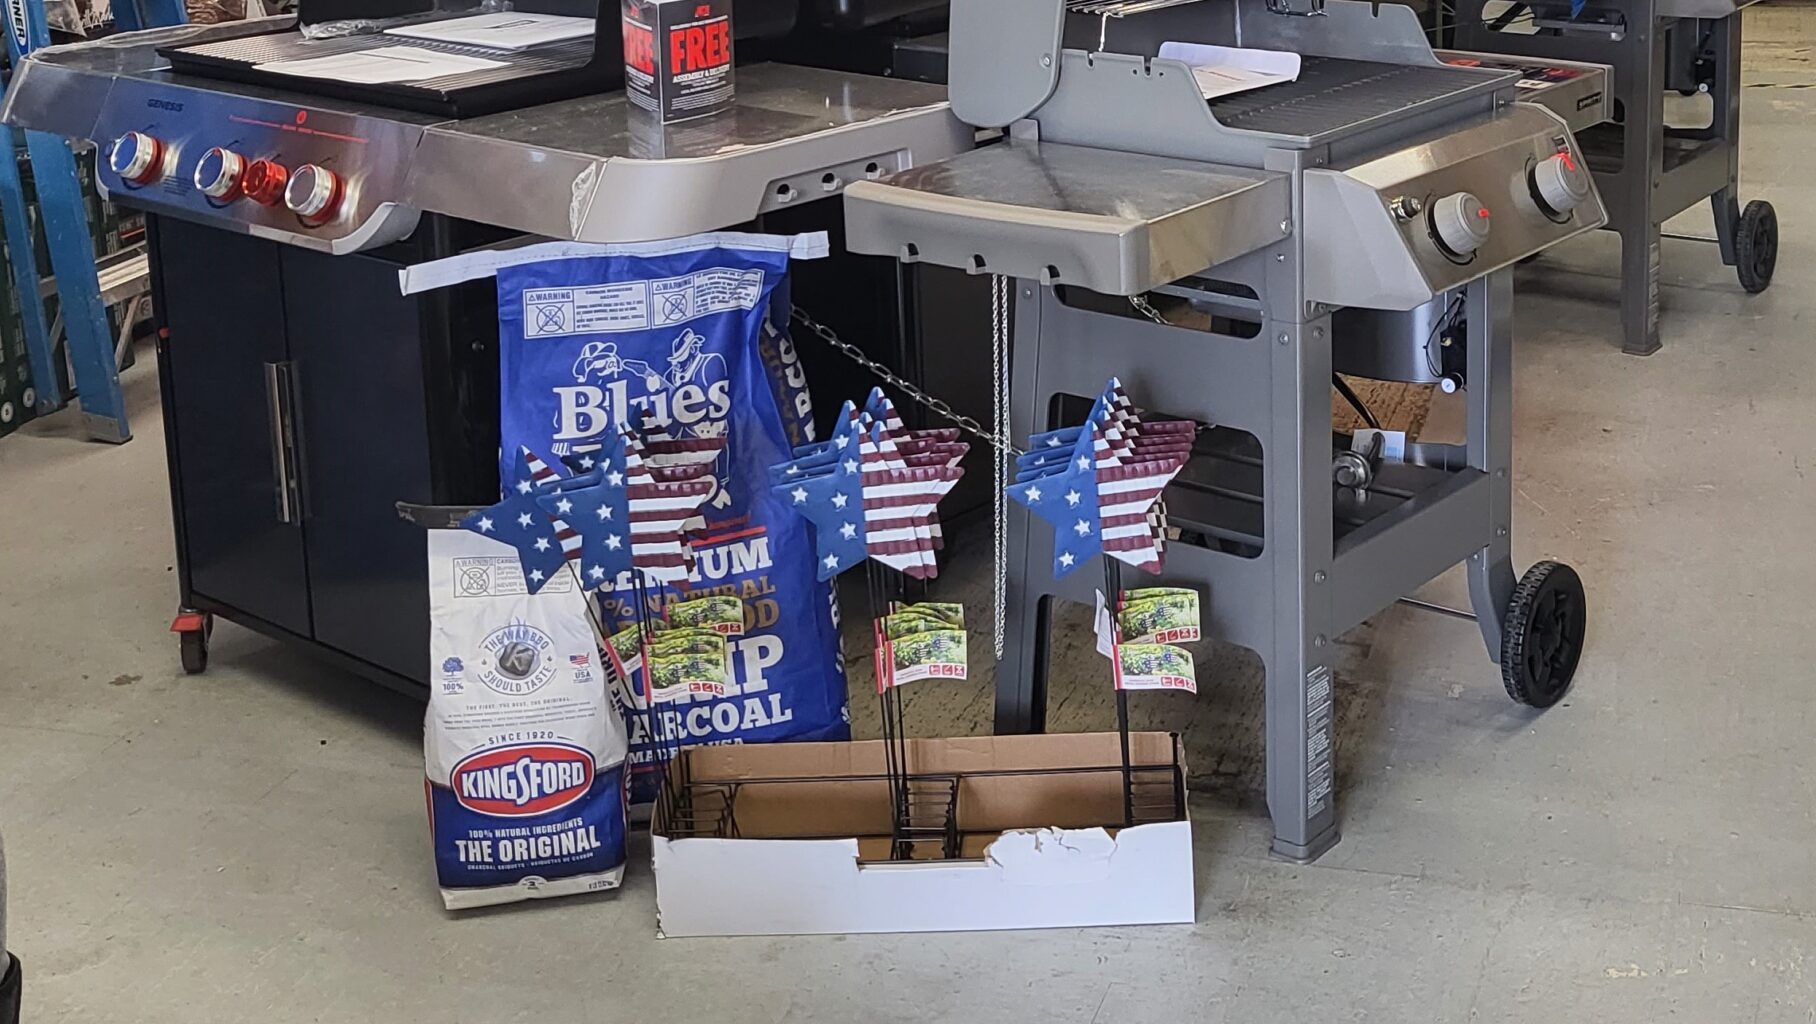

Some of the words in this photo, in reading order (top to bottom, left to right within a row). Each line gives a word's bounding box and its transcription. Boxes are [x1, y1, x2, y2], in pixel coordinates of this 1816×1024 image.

[669, 20, 731, 75] FREE
[147, 98, 185, 112] GENESIS
[661, 278, 692, 291] WARNING
[535, 291, 571, 301] WARNING
[483, 634, 504, 653] THE
[483, 669, 523, 693] SHOULD
[525, 664, 553, 691] TASTE
[574, 670, 593, 680] USA
[441, 682, 465, 692] 100%
[488, 732, 522, 745] SINCE
[526, 731, 554, 740] 1920
[461, 757, 585, 806] KINGSFORD
[468, 828, 494, 839] 100%
[495, 827, 531, 838] NATURAL
[532, 816, 583, 836] INGREDIENTS
[455, 839, 493, 863] THE
[499, 825, 602, 863] ORIGINAL
